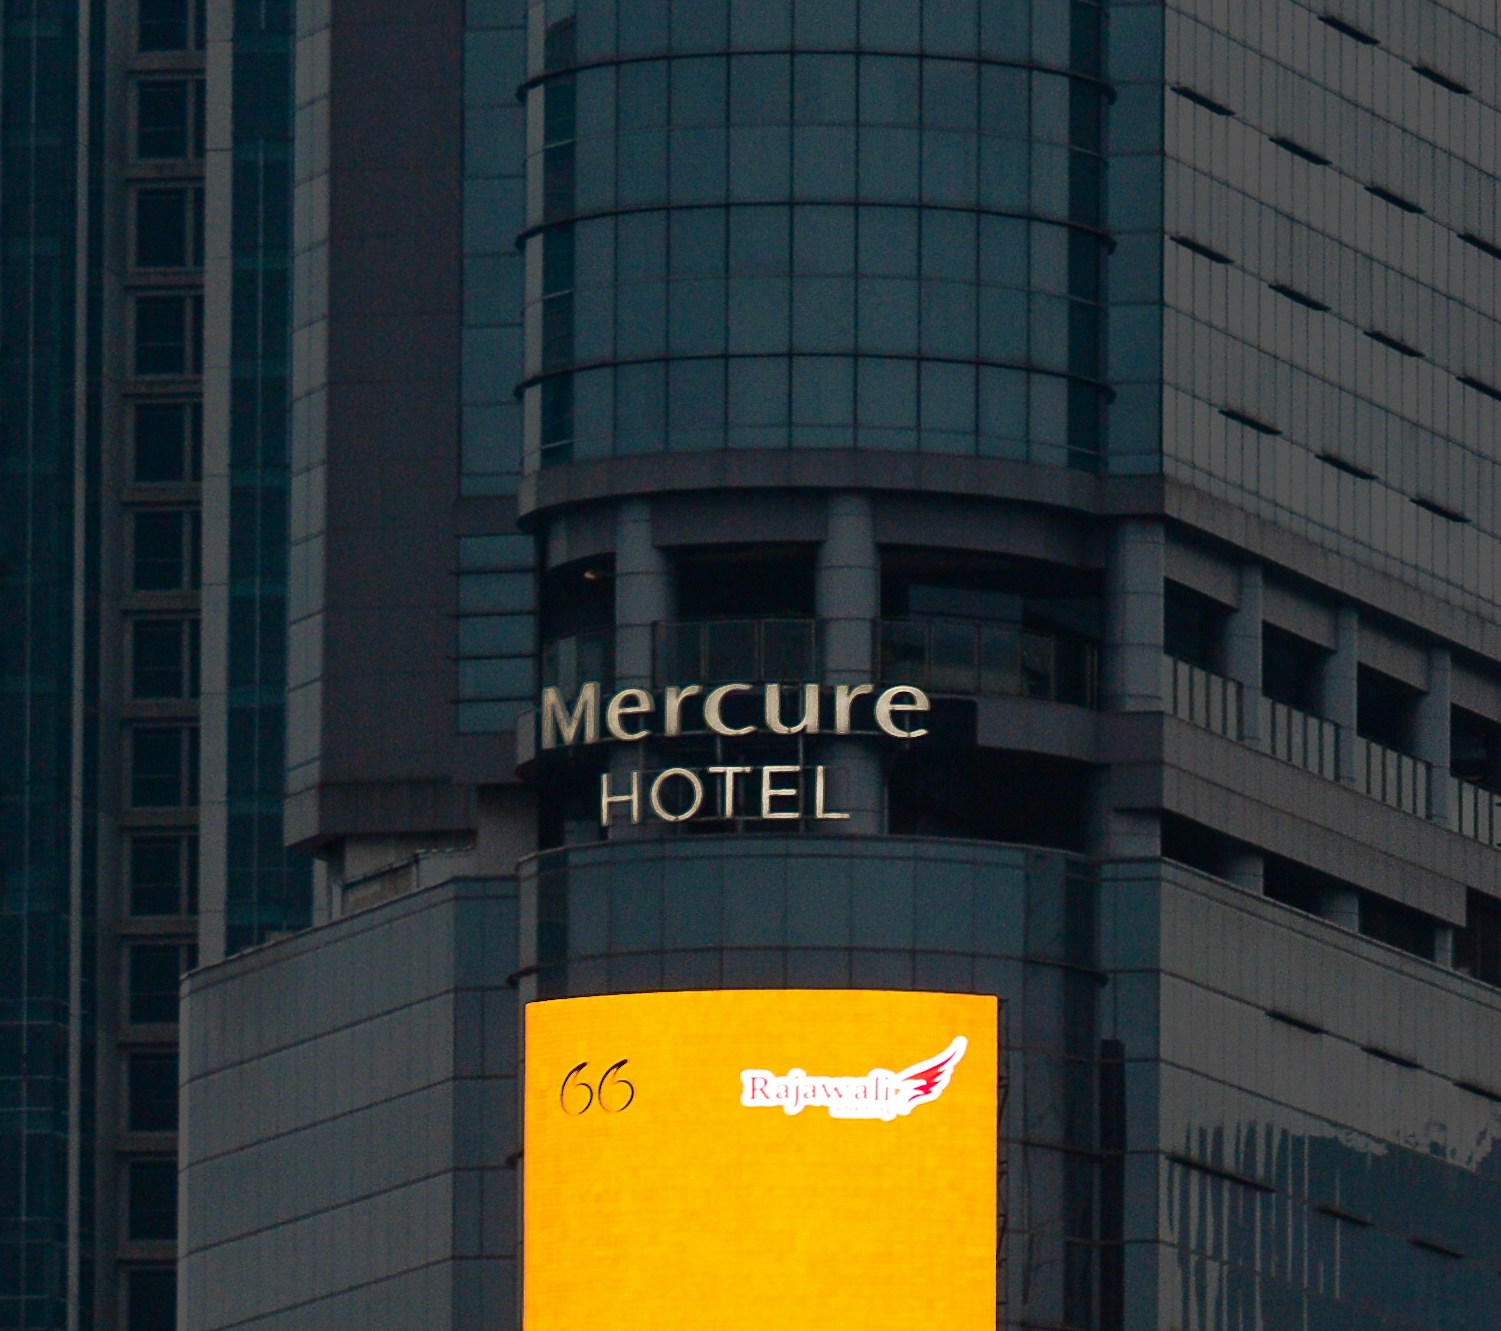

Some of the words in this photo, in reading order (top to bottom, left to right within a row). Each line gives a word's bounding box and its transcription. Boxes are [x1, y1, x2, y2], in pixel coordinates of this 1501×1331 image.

[541, 681, 931, 750] Mercure
[601, 765, 851, 828] HOTEL
[750, 1076, 891, 1107] Rajawali
